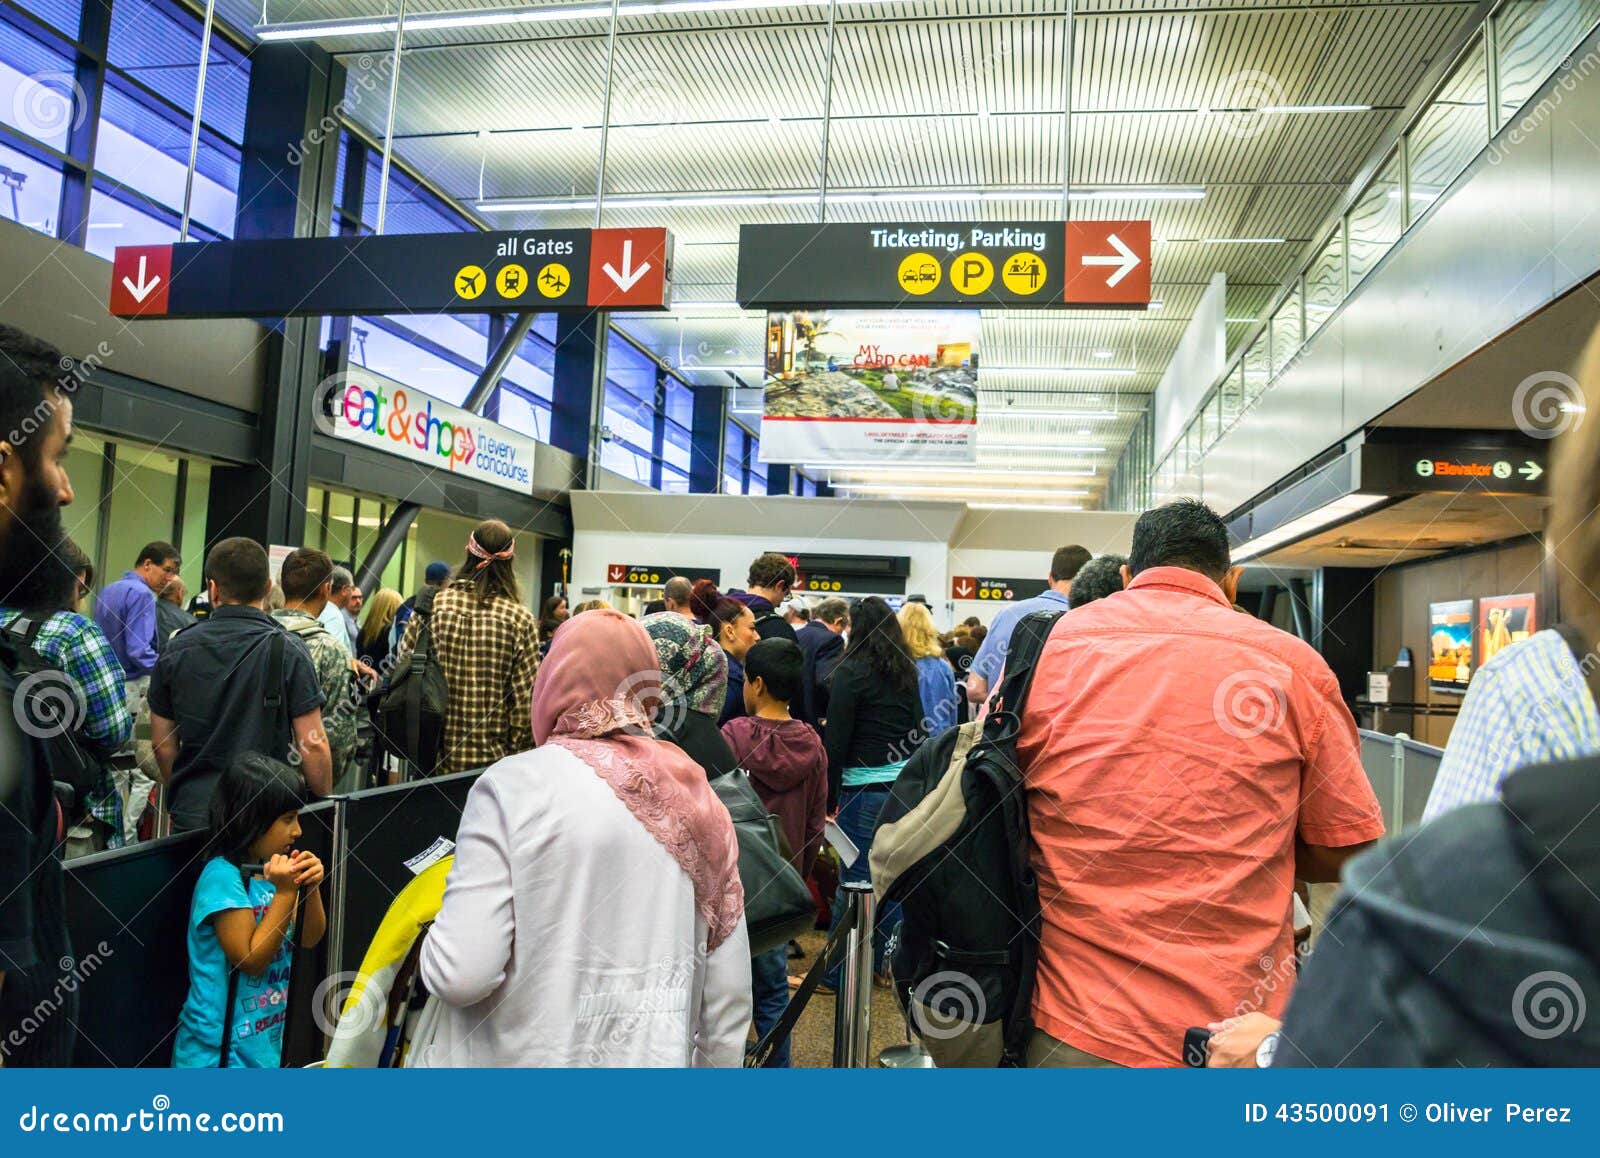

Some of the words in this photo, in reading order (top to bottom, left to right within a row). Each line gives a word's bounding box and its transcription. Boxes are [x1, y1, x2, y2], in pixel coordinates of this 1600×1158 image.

[497, 237, 518, 257] all
[523, 238, 574, 256] Gates
[870, 228, 966, 252] Ticketing,
[971, 228, 1046, 252] Parking
[853, 354, 896, 369] CARD
[898, 353, 930, 369] CAN
[859, 344, 881, 356] MY
[343, 385, 388, 437] eat
[387, 389, 412, 445] &
[414, 399, 467, 472] shop
[477, 427, 487, 451] in
[488, 436, 517, 461] every
[476, 451, 529, 484] concourse.
